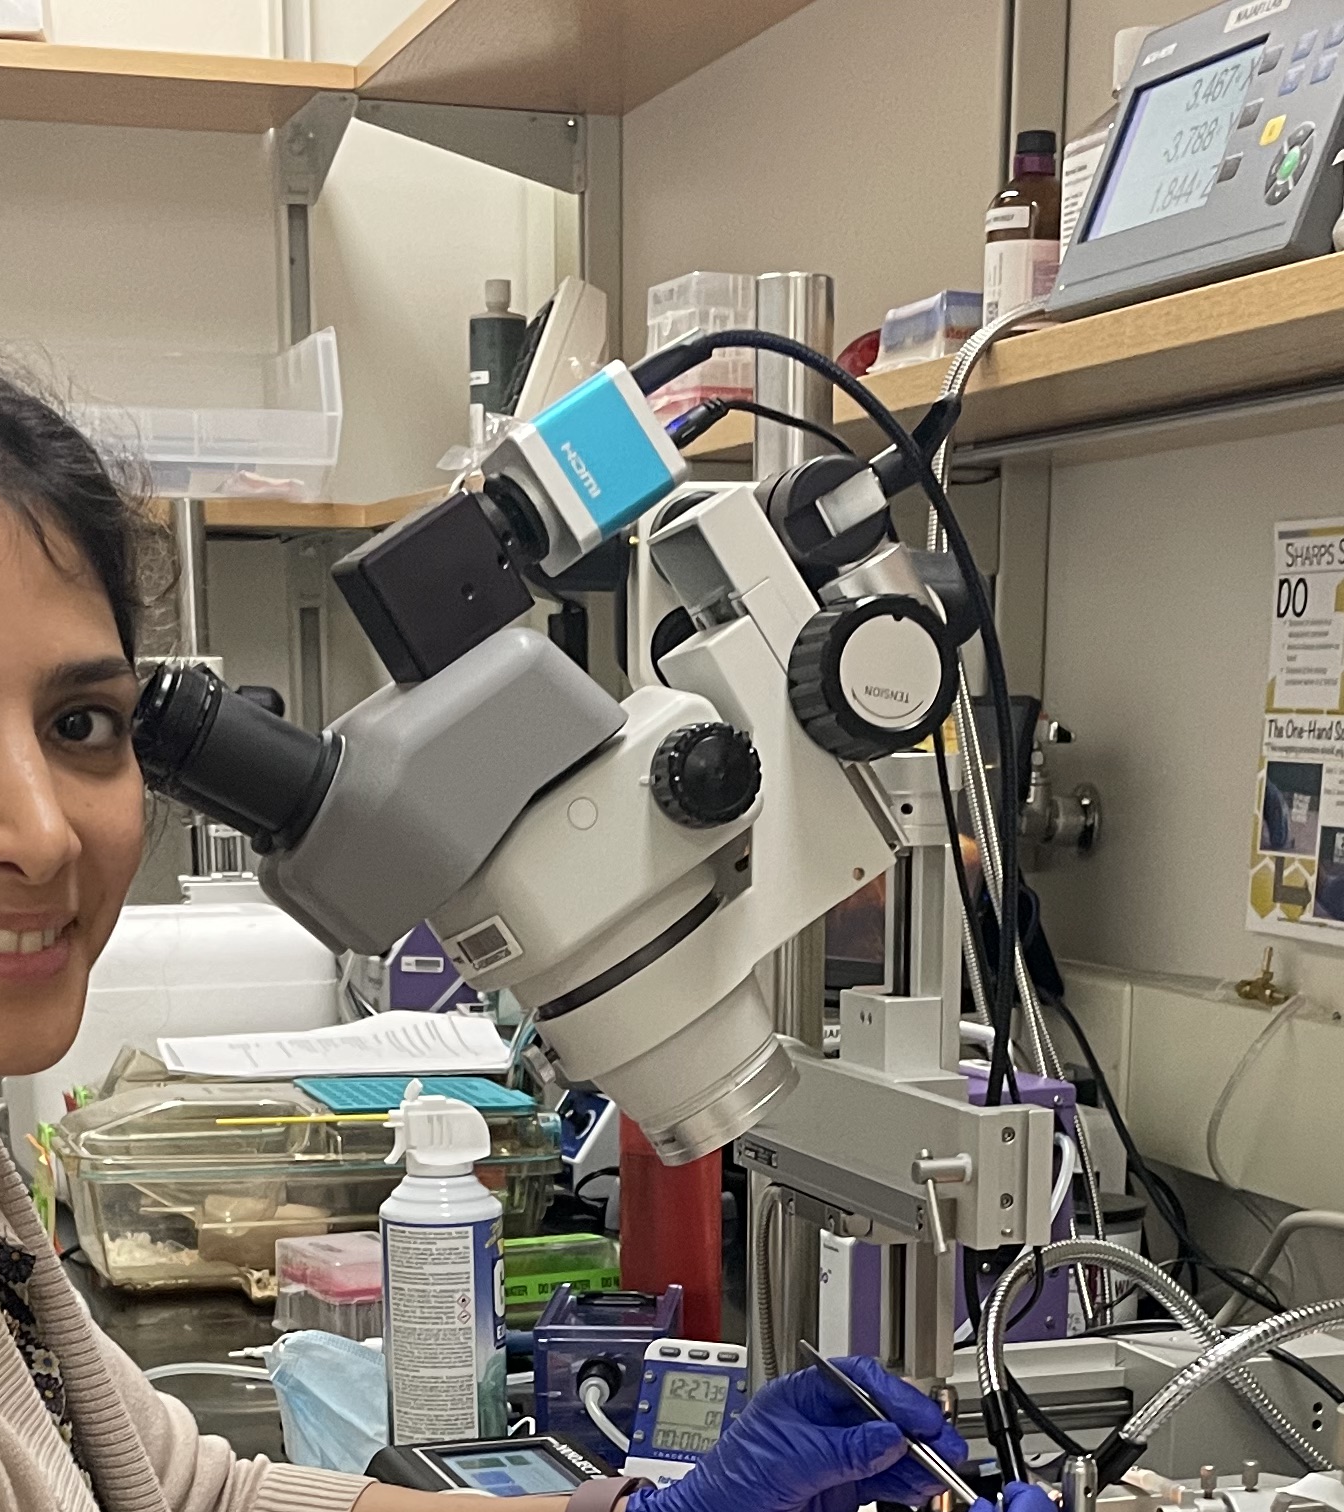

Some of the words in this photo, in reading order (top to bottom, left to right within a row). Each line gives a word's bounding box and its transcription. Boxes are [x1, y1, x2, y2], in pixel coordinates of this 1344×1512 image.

[1186, 63, 1240, 112] 3.467
[1149, 170, 1200, 215] 1.844
[561, 441, 601, 499] HDMI
[1285, 542, 1335, 568] SHARPS
[1277, 577, 1308, 618] DO
[864, 685, 909, 704] TENSION
[1268, 719, 1284, 739] The
[1285, 718, 1333, 741] One-Hand
